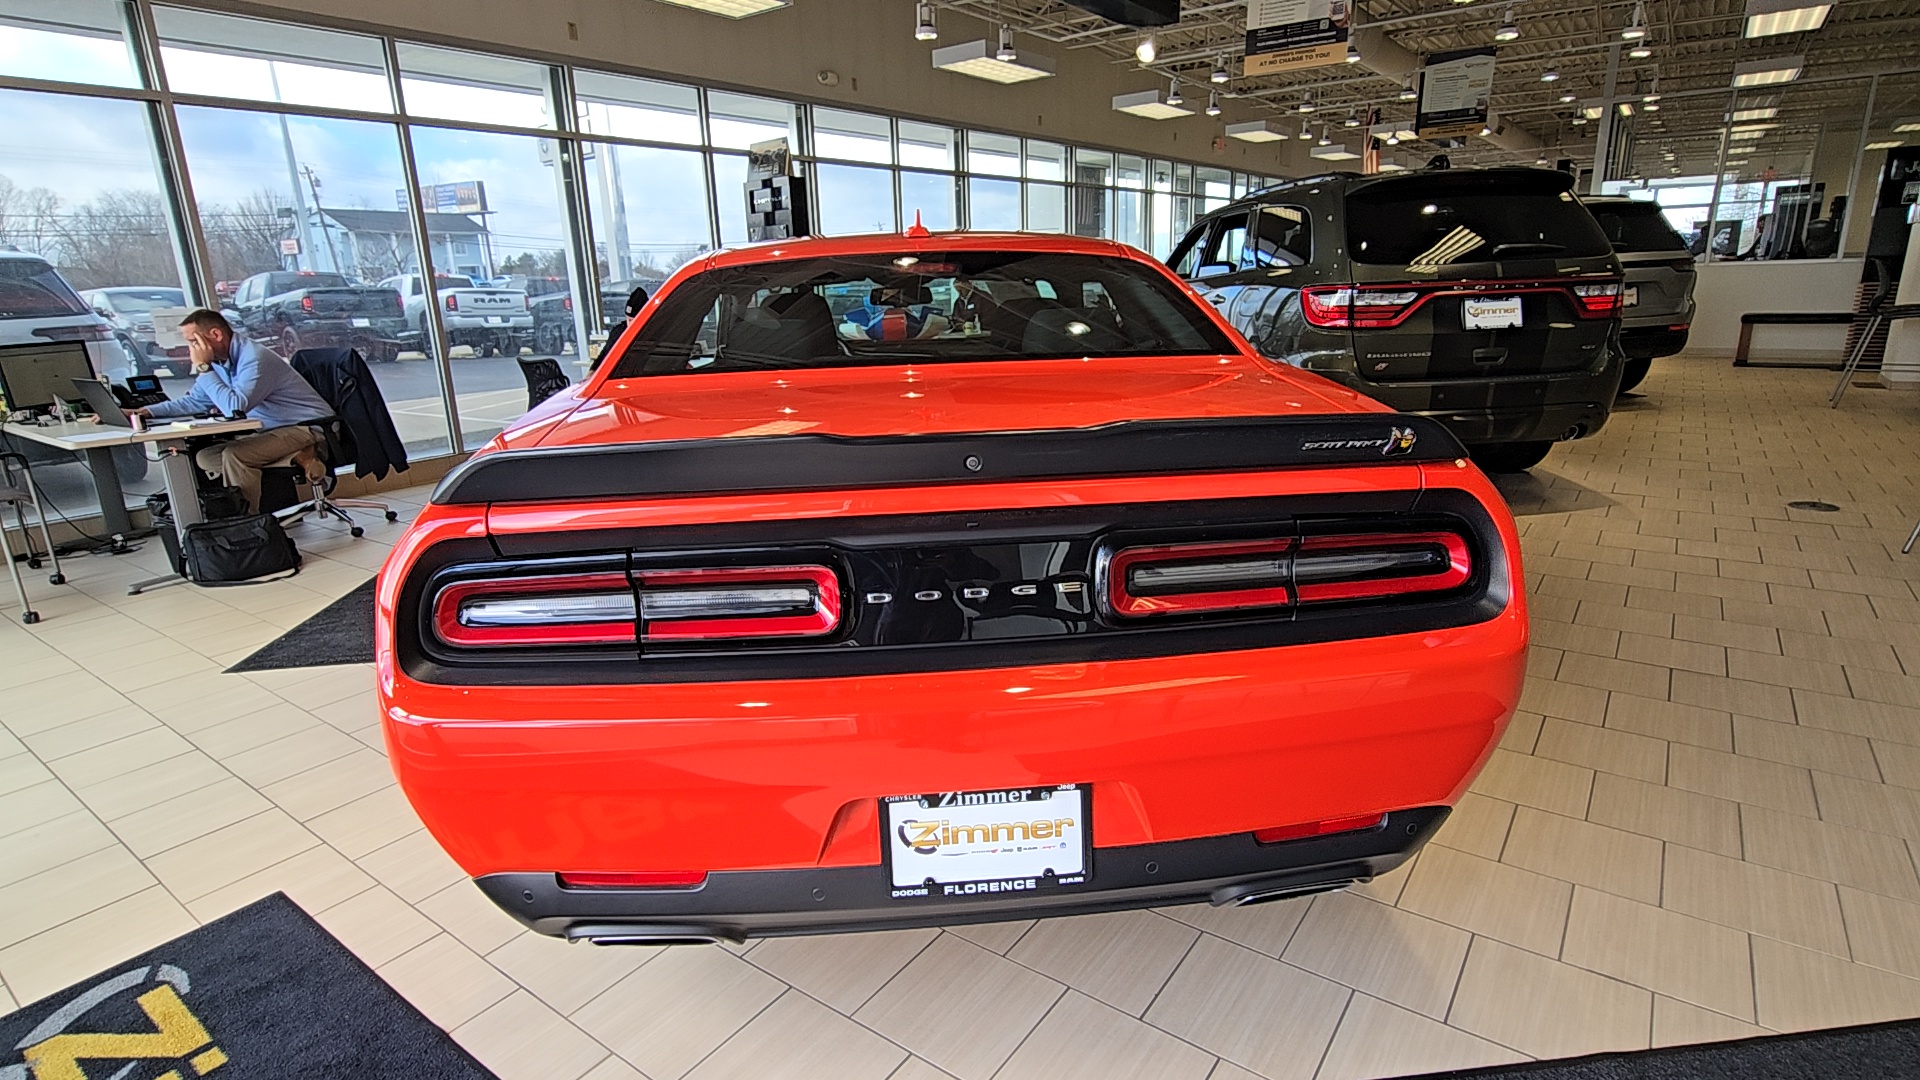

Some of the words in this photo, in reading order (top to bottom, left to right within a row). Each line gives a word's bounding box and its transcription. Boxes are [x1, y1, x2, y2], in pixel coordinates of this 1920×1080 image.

[1279, 55, 1304, 64] CHARGE
[1469, 306, 1519, 317] Zimmer
[1301, 440, 1347, 450] SCAT
[1345, 438, 1389, 449] PACK
[866, 581, 1083, 604] DODGE
[1057, 783, 1076, 791] Jeep
[885, 794, 922, 803] CHRYSLER
[938, 788, 1032, 808] Zimmer
[908, 818, 1075, 848] Zimmer
[1058, 876, 1085, 885] RAM
[891, 888, 929, 898] DODGE
[943, 879, 1037, 896] FLORENCE
